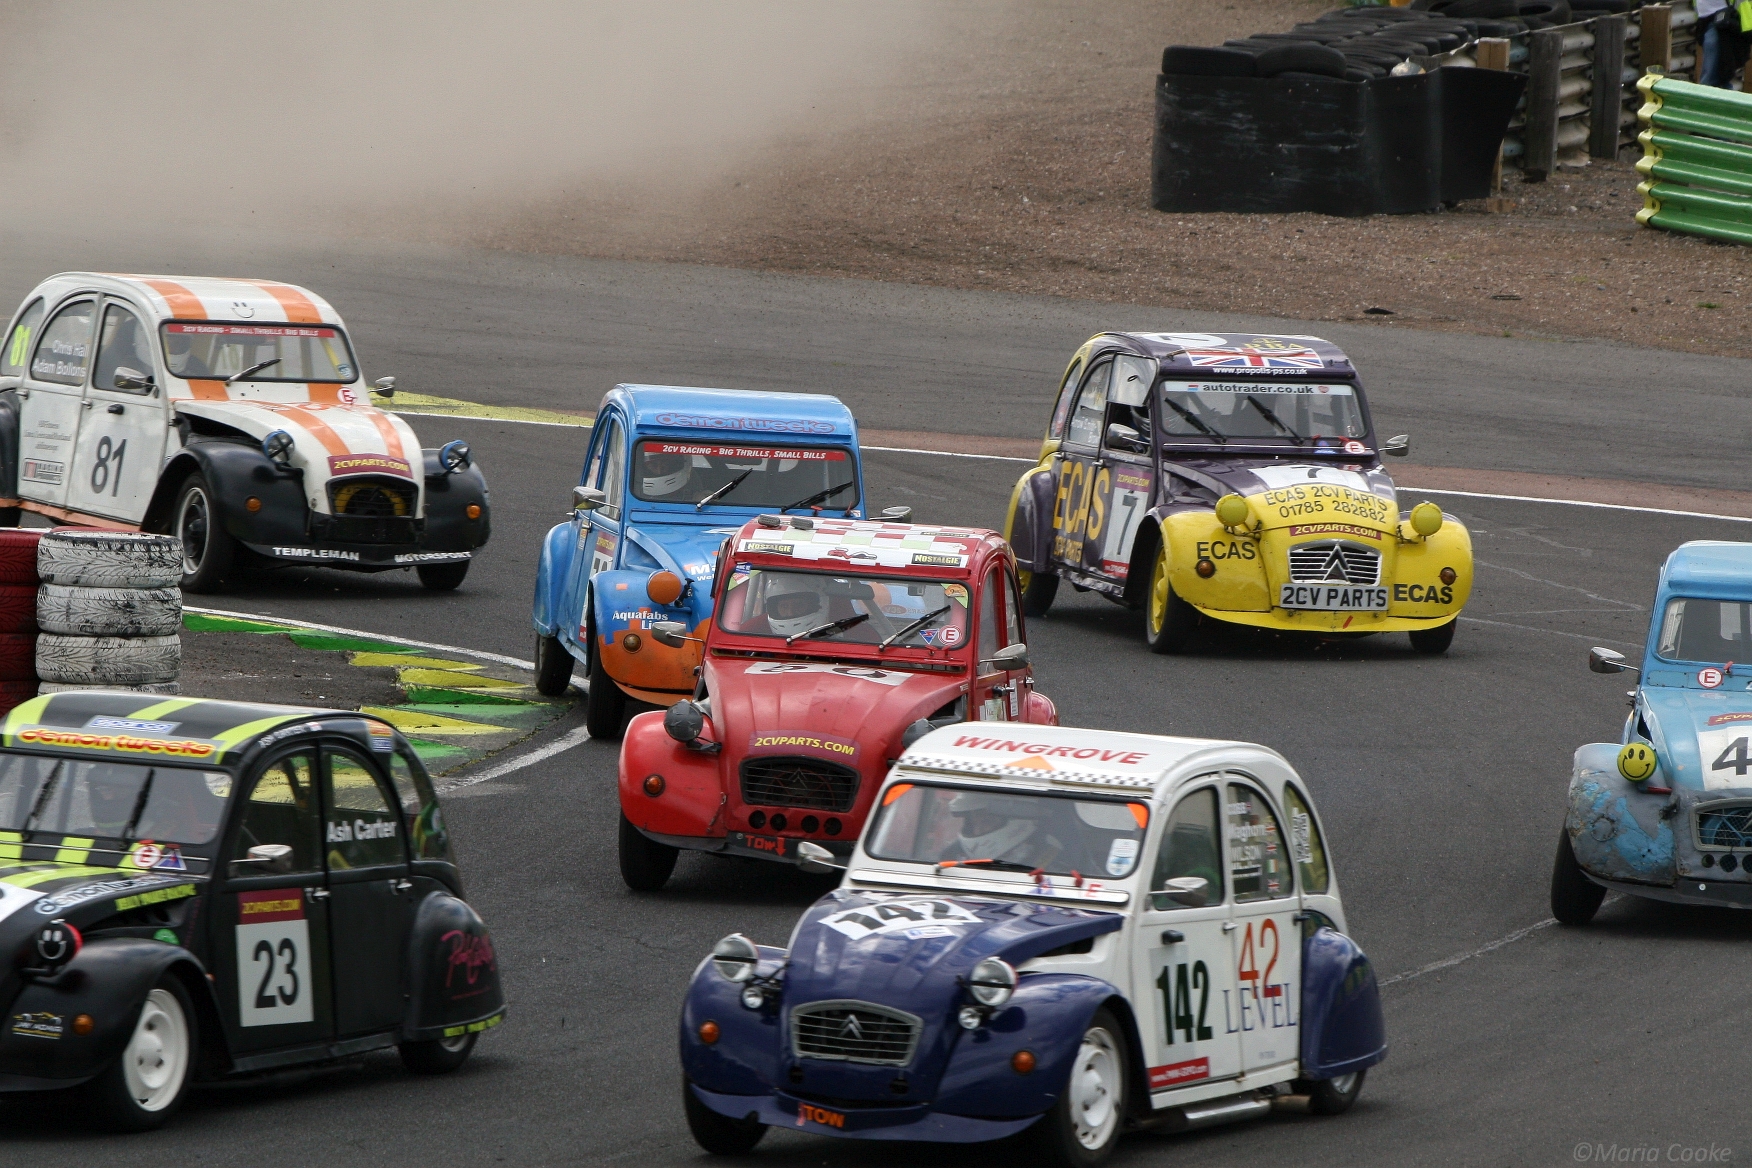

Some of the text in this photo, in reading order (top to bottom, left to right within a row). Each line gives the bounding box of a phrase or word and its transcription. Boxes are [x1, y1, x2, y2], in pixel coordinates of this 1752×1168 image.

[9, 325, 31, 366] 81
[1213, 367, 1308, 375] www.propolis-ps.co.uk
[1203, 384, 1314, 394] autotrader.co.uk
[663, 445, 678, 453] 2CV
[680, 446, 711, 454] RACING
[774, 450, 801, 459] SMALL
[91, 436, 127, 497] 81
[334, 458, 409, 472] 2CVPARTS.COM
[1053, 461, 1110, 540] ECAS
[1264, 486, 1388, 512] ECAS 2CV PARTS
[1279, 500, 1387, 524] 01785 282882
[1117, 495, 1138, 556] 7
[1294, 524, 1377, 538] 2CVPARTS.COM
[272, 547, 472, 563] TEMPLEMAN MOTORSPORT
[747, 542, 793, 554] NOSTALGIE
[1196, 541, 1256, 560] ECAS
[914, 554, 960, 565] NOSTALGIE
[1282, 586, 1387, 608] 2CV PARTS
[1393, 584, 1453, 604] ECAS
[612, 611, 669, 621] Aquafabs
[945, 630, 955, 640] E
[1704, 672, 1716, 683] E
[754, 737, 855, 755] 2CVPARTS.COM
[953, 735, 1150, 764] WINGROVE
[326, 818, 397, 842] Ash Carter
[833, 901, 970, 930] 142
[1238, 918, 1282, 1000] 42
[253, 938, 299, 1008] 23
[1156, 960, 1214, 1045] 142
[1222, 983, 1297, 1034] LEVEL
[803, 1104, 845, 1128] TOW
